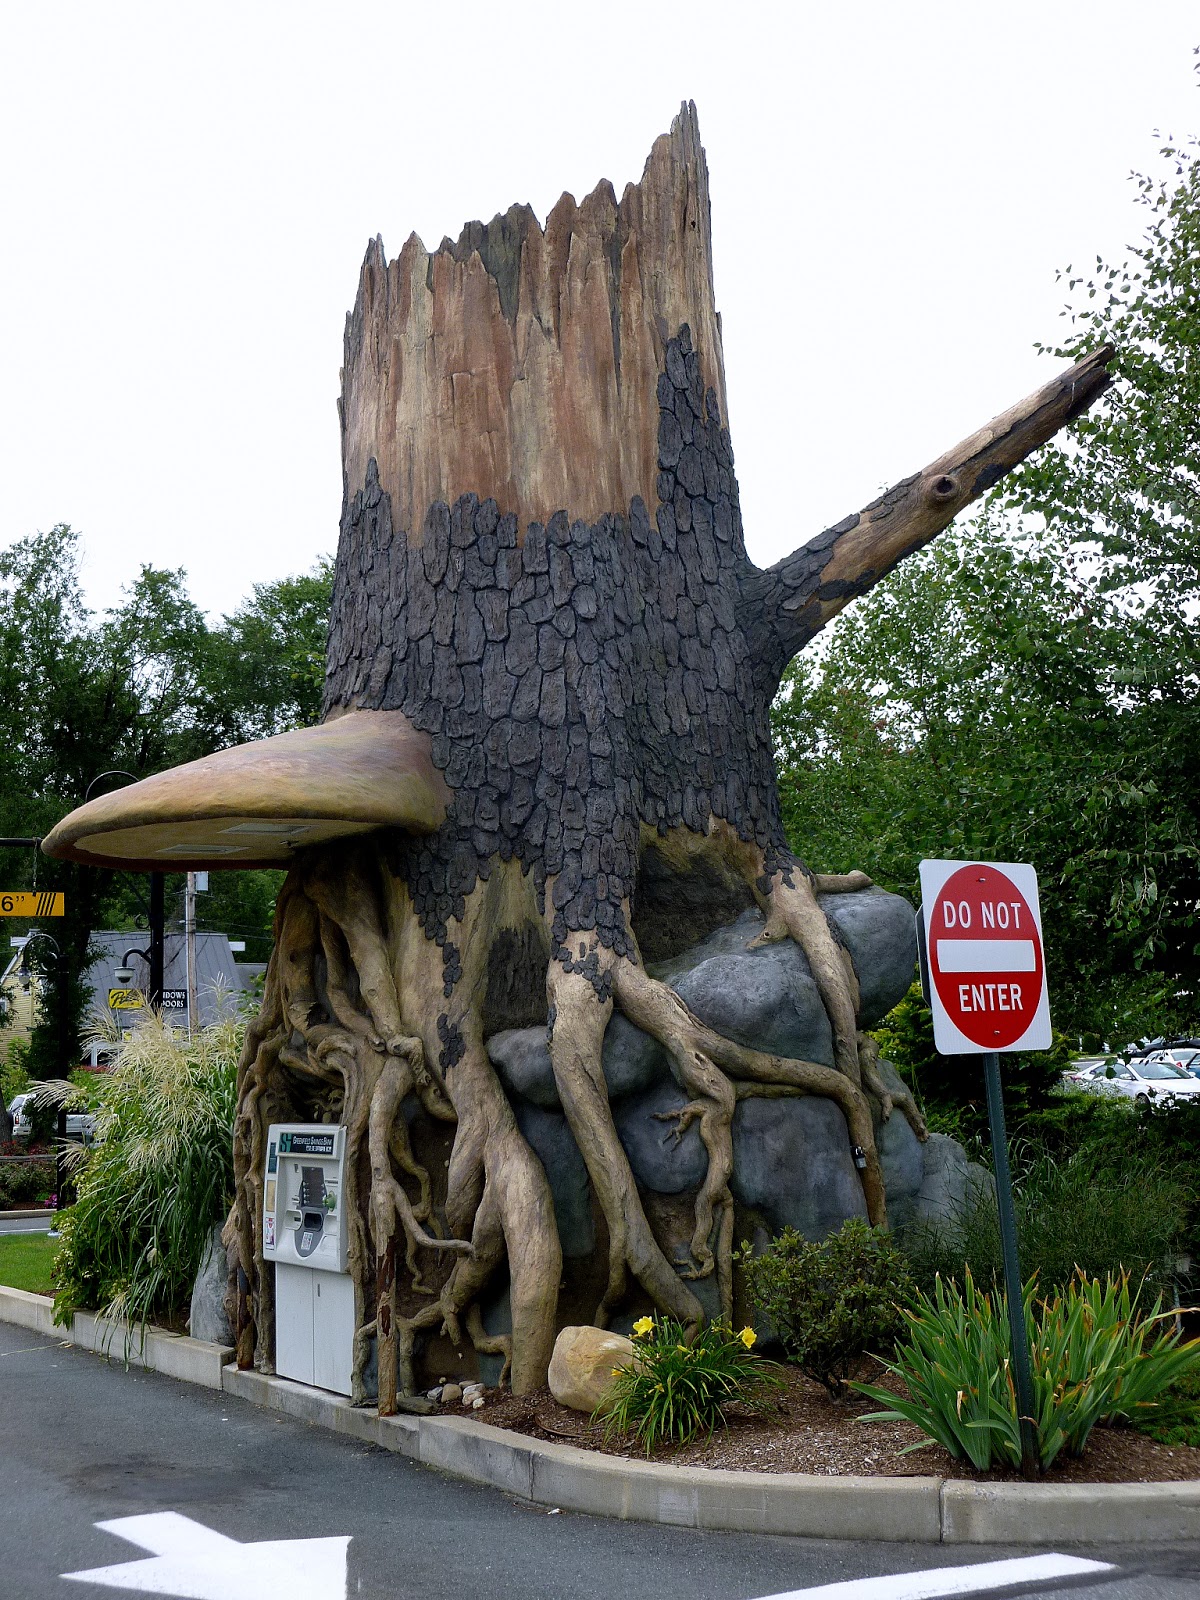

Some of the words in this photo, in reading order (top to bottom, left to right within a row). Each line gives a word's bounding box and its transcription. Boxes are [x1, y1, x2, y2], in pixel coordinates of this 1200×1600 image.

[943, 901, 972, 929] DO
[981, 901, 1021, 929] NOT
[958, 984, 1024, 1012] ENTER
